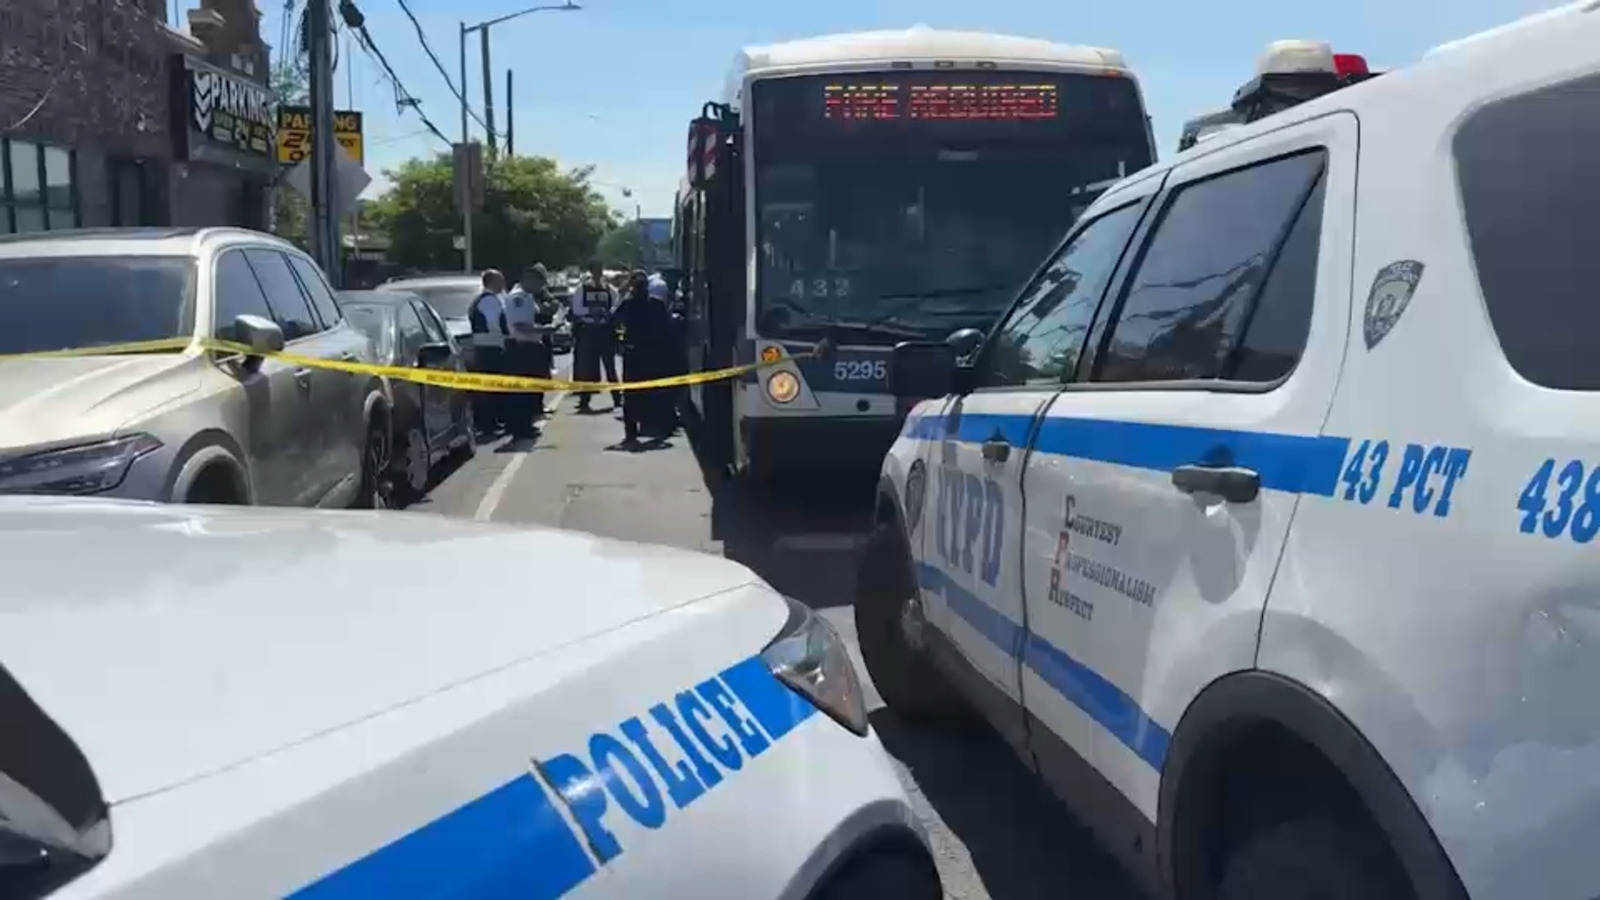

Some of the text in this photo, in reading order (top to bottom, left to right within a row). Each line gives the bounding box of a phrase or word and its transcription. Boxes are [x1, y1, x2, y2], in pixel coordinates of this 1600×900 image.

[211, 72, 268, 124] PARKING
[283, 113, 356, 131] PARNG
[824, 85, 1057, 118] FARE REQUIRED
[834, 360, 887, 380] 5295
[1343, 440, 1472, 518] 43 PCT
[935, 466, 1004, 588] NYPD
[537, 677, 772, 866] POLICE
